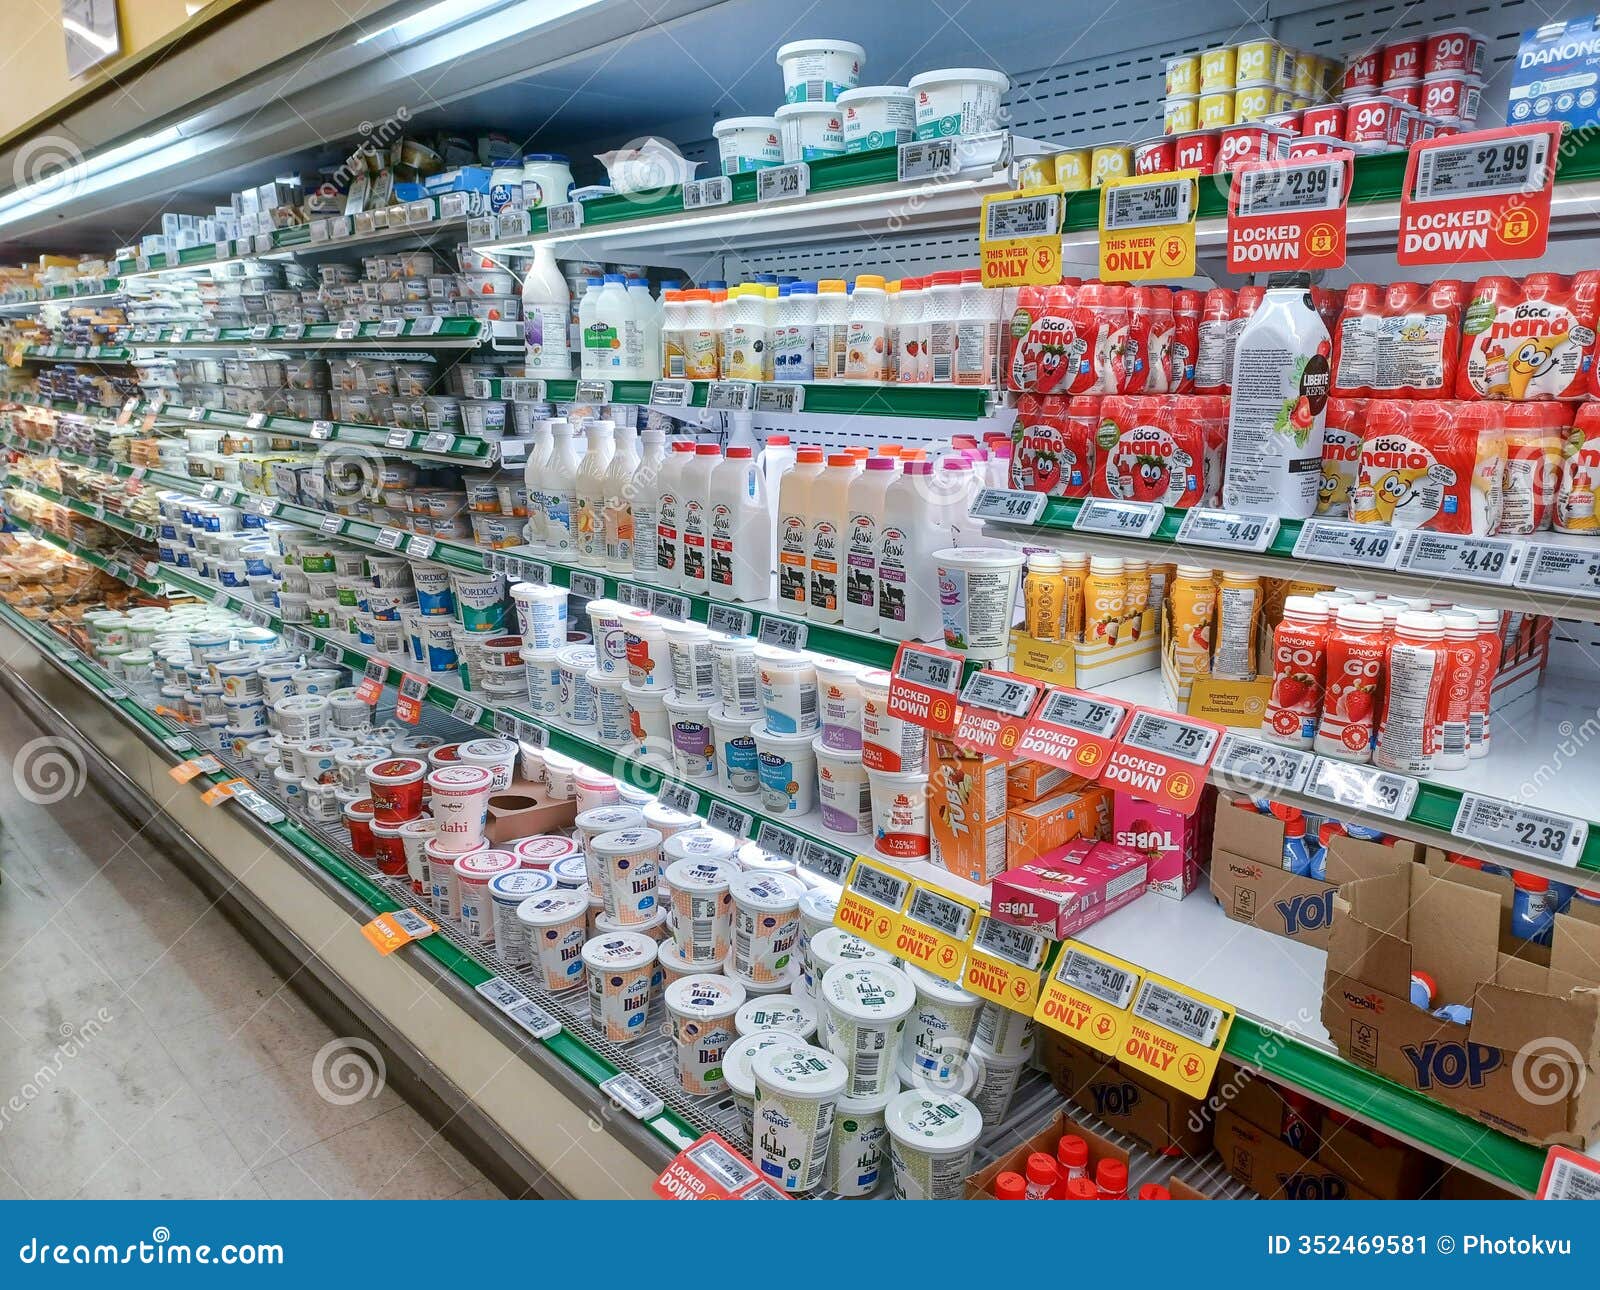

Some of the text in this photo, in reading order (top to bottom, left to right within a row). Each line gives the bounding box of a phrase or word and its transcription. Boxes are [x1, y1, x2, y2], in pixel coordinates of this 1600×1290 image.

[927, 149, 951, 169] $7.79
[1180, 142, 1204, 168] ni
[1477, 143, 1529, 175] $2.99
[1286, 169, 1328, 195] $2.99
[1405, 209, 1491, 231] LOCKED
[1106, 237, 1156, 251] THIS WEEK
[1233, 225, 1301, 243] LOCKED
[1404, 229, 1488, 253] DOWN
[986, 247, 1028, 260] THIS WEEK
[1106, 250, 1155, 272] ONLY
[1233, 242, 1299, 262] DOWN
[986, 259, 1029, 279] ONLY
[1005, 498, 1031, 517] $4.49
[1117, 510, 1148, 529] $4.49
[783, 527, 805, 544] Lassi
[813, 532, 836, 550] Lassi
[851, 526, 873, 545] Lassi
[1226, 521, 1260, 542] $4.49
[881, 539, 905, 557] Lassi
[1350, 536, 1389, 558] $4.49
[1420, 546, 1447, 555] YOGURT
[1421, 541, 1458, 551] DRINKABLE
[1459, 549, 1504, 573] $4.49
[1540, 560, 1571, 569] YOGURT
[1542, 555, 1585, 565] DRINKABLE
[459, 584, 499, 597] NORDICA
[1095, 597, 1123, 611] GO
[1277, 649, 1323, 668] GO!
[1343, 659, 1381, 676] GO
[928, 665, 950, 685] $3.99
[891, 685, 930, 705] LOCKED
[1000, 683, 1024, 701] 75¢
[890, 696, 929, 719] DOWN
[1085, 704, 1111, 723] 75¢
[677, 723, 701, 732] CEDAR
[962, 713, 1001, 732] LOCKED
[733, 738, 756, 747] CEDA
[957, 725, 997, 748] DOWN
[1028, 727, 1079, 748] LOCKED
[1175, 727, 1204, 747] 75¢
[1021, 737, 1073, 761] DOWN
[1110, 751, 1167, 777] LOCKED
[1260, 755, 1298, 780] $2.33
[1104, 765, 1162, 793] DOWN
[440, 821, 468, 833] dahi
[1515, 822, 1567, 852] $2.33
[1117, 831, 1180, 851] TUBES
[1022, 864, 1089, 886] TUBES
[632, 876, 658, 895] Dahi
[844, 898, 876, 918] THIS WEEK
[999, 901, 1039, 919] TUBES
[840, 907, 873, 932] ONLY
[901, 924, 938, 946] THIS WEEK
[896, 934, 936, 961] ONLY
[971, 958, 1009, 980] THIS WEEK
[856, 981, 882, 995] Halal
[969, 968, 1008, 996] ONLY
[623, 992, 650, 1013] Dahi
[1050, 988, 1093, 1015] THIS WEEK
[918, 1013, 948, 1031] KHAAS
[1043, 999, 1089, 1031] ONLY
[1175, 1001, 1210, 1029] 2/$5.00
[702, 1034, 730, 1047] KHAAS
[915, 1032, 943, 1055] Halal
[1131, 1026, 1179, 1055] THIS WEEK
[1126, 1038, 1176, 1072] ONLY
[1400, 1040, 1505, 1090] YOP
[1089, 1082, 1139, 1116] YOP
[762, 1111, 791, 1129] KHAAS
[760, 1133, 787, 1158] Halal
[669, 1161, 706, 1194] LOCKED
